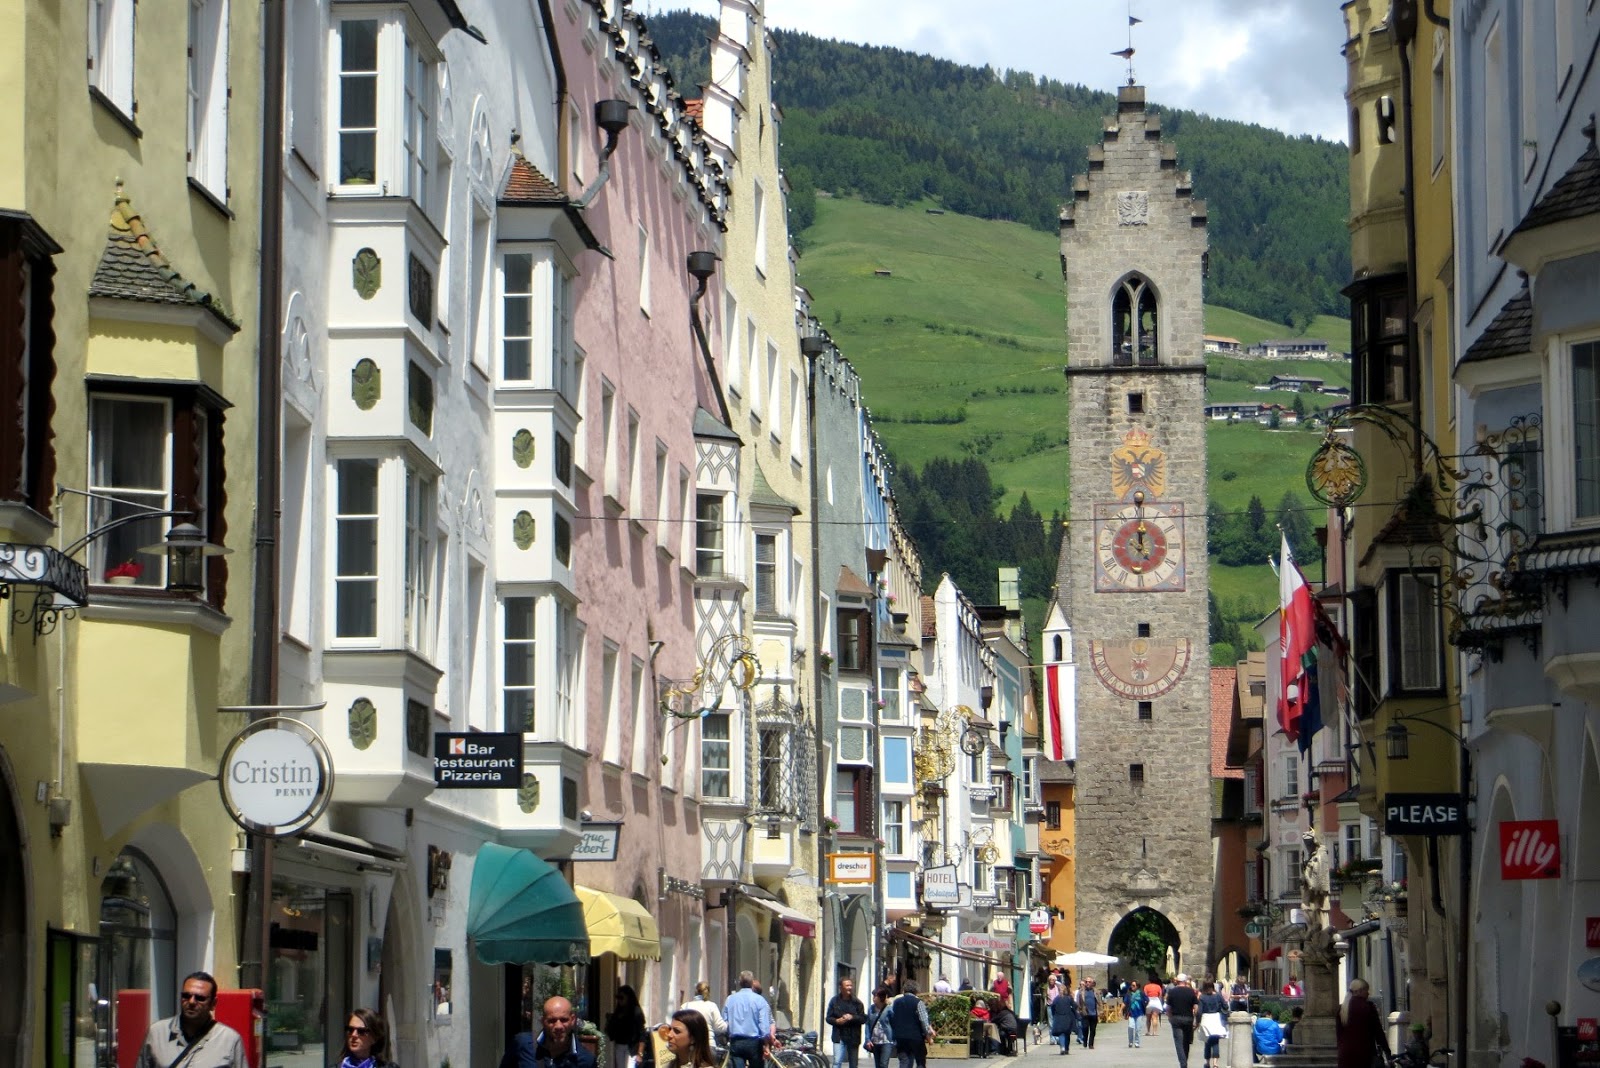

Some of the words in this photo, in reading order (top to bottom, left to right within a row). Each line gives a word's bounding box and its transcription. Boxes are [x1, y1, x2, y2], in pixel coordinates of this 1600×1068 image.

[467, 743, 495, 754] Bar
[232, 759, 313, 784] Cristin
[441, 769, 502, 781] Pizzeria
[275, 788, 313, 797] PENNY
[1387, 805, 1457, 823] PLEASE
[1504, 828, 1556, 875] illy
[926, 872, 955, 884] HOTEL
